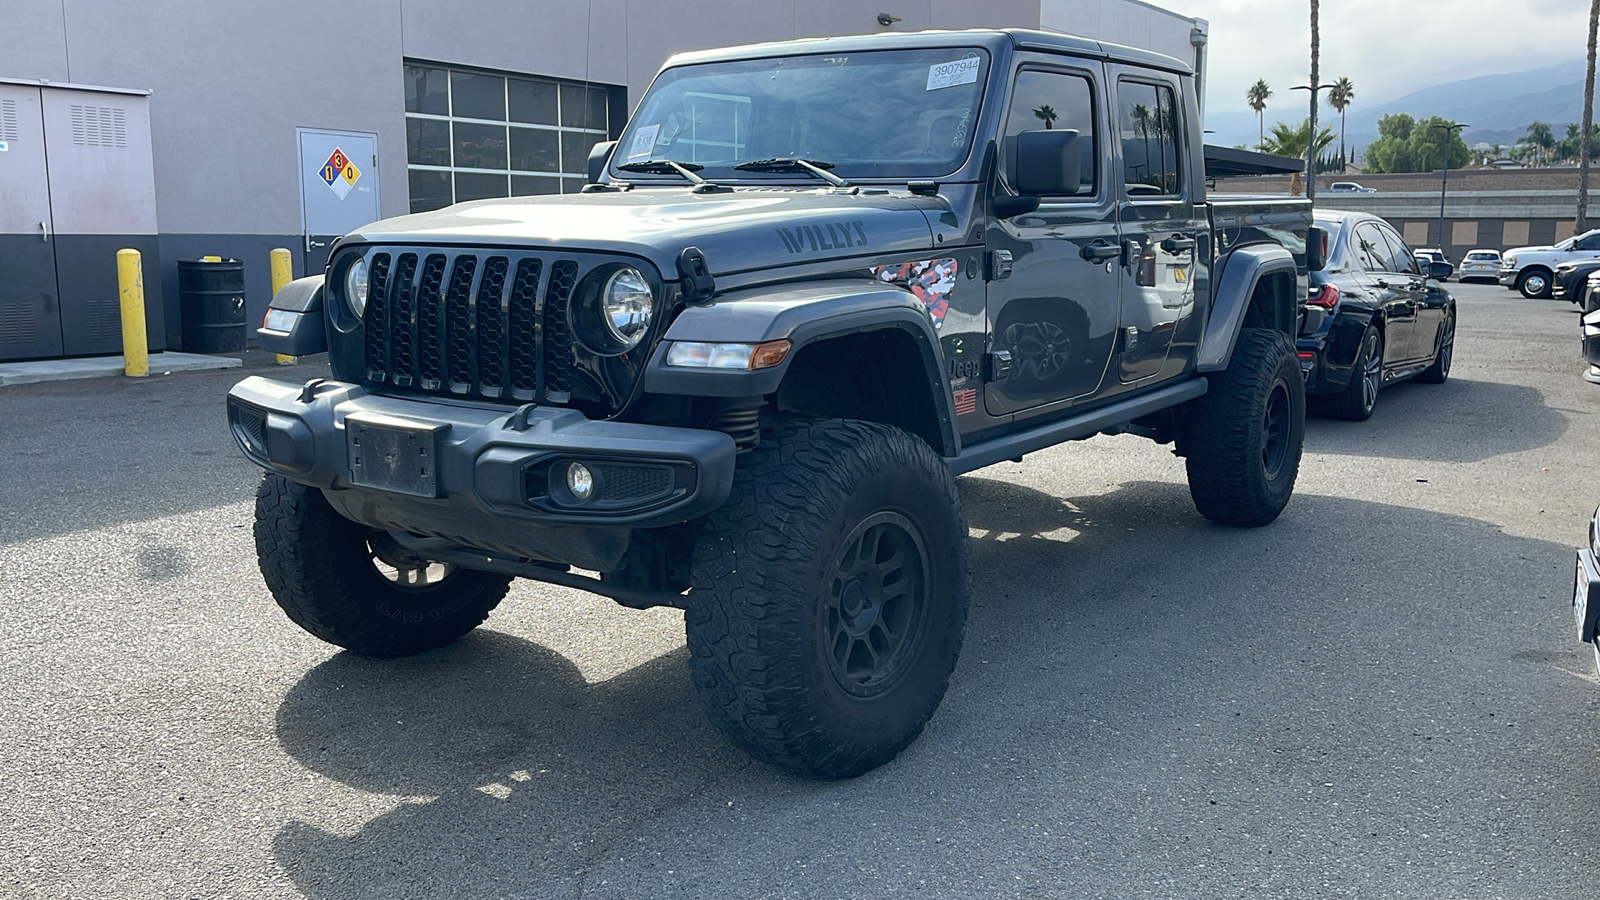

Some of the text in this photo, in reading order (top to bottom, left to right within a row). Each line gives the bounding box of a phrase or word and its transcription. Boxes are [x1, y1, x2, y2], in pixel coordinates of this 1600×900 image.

[934, 60, 979, 77] 3907944
[335, 154, 341, 167] 3
[327, 167, 332, 180] 1
[347, 167, 353, 180] 0
[774, 220, 868, 254] WILLYS
[949, 359, 980, 379] Jeep
